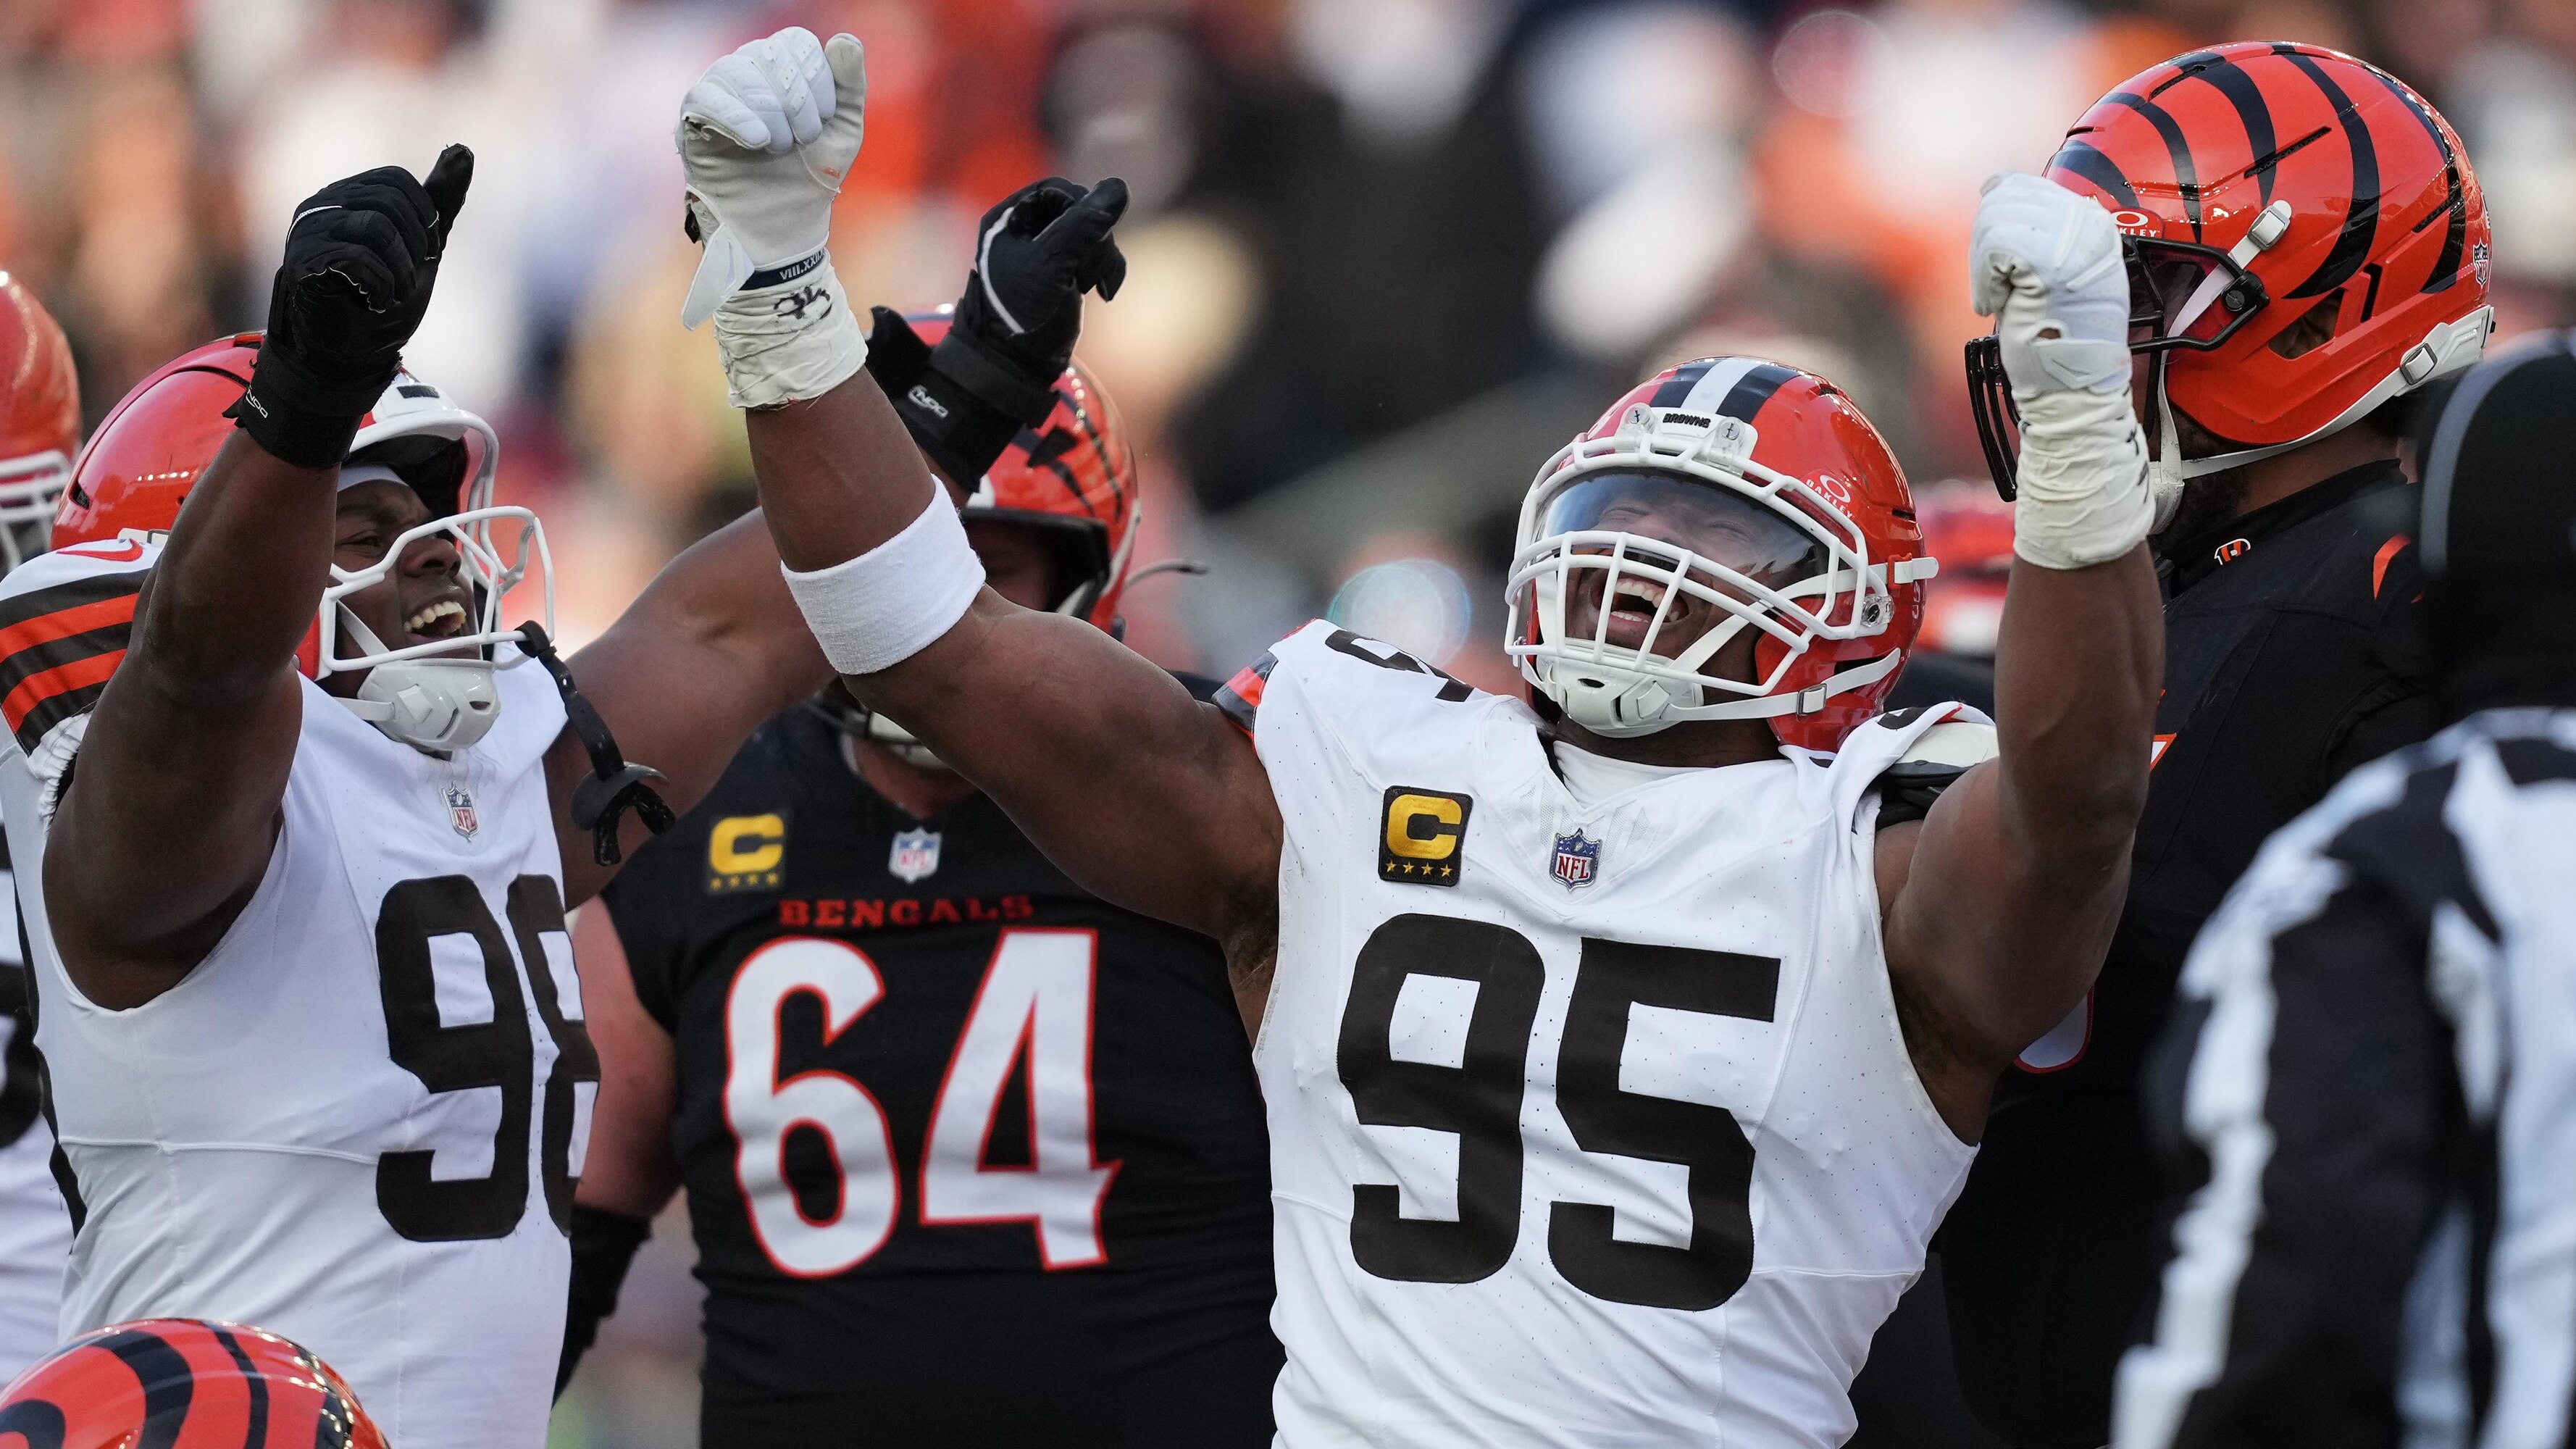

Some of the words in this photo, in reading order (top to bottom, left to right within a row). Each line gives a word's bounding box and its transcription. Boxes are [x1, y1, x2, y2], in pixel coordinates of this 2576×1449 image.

[2119, 227, 2157, 237] KLEY
[1663, 413, 1710, 428] BROWNS
[1805, 478, 1853, 519] OAKLEY
[454, 808, 477, 830] NFL
[1387, 794, 1462, 860] C
[709, 813, 785, 874] C
[1557, 855, 1589, 881] NFL
[778, 895, 1034, 928] BENGALS
[375, 874, 601, 1242] 98
[722, 927, 1123, 1279] 64
[1337, 912, 1781, 1311] 95
